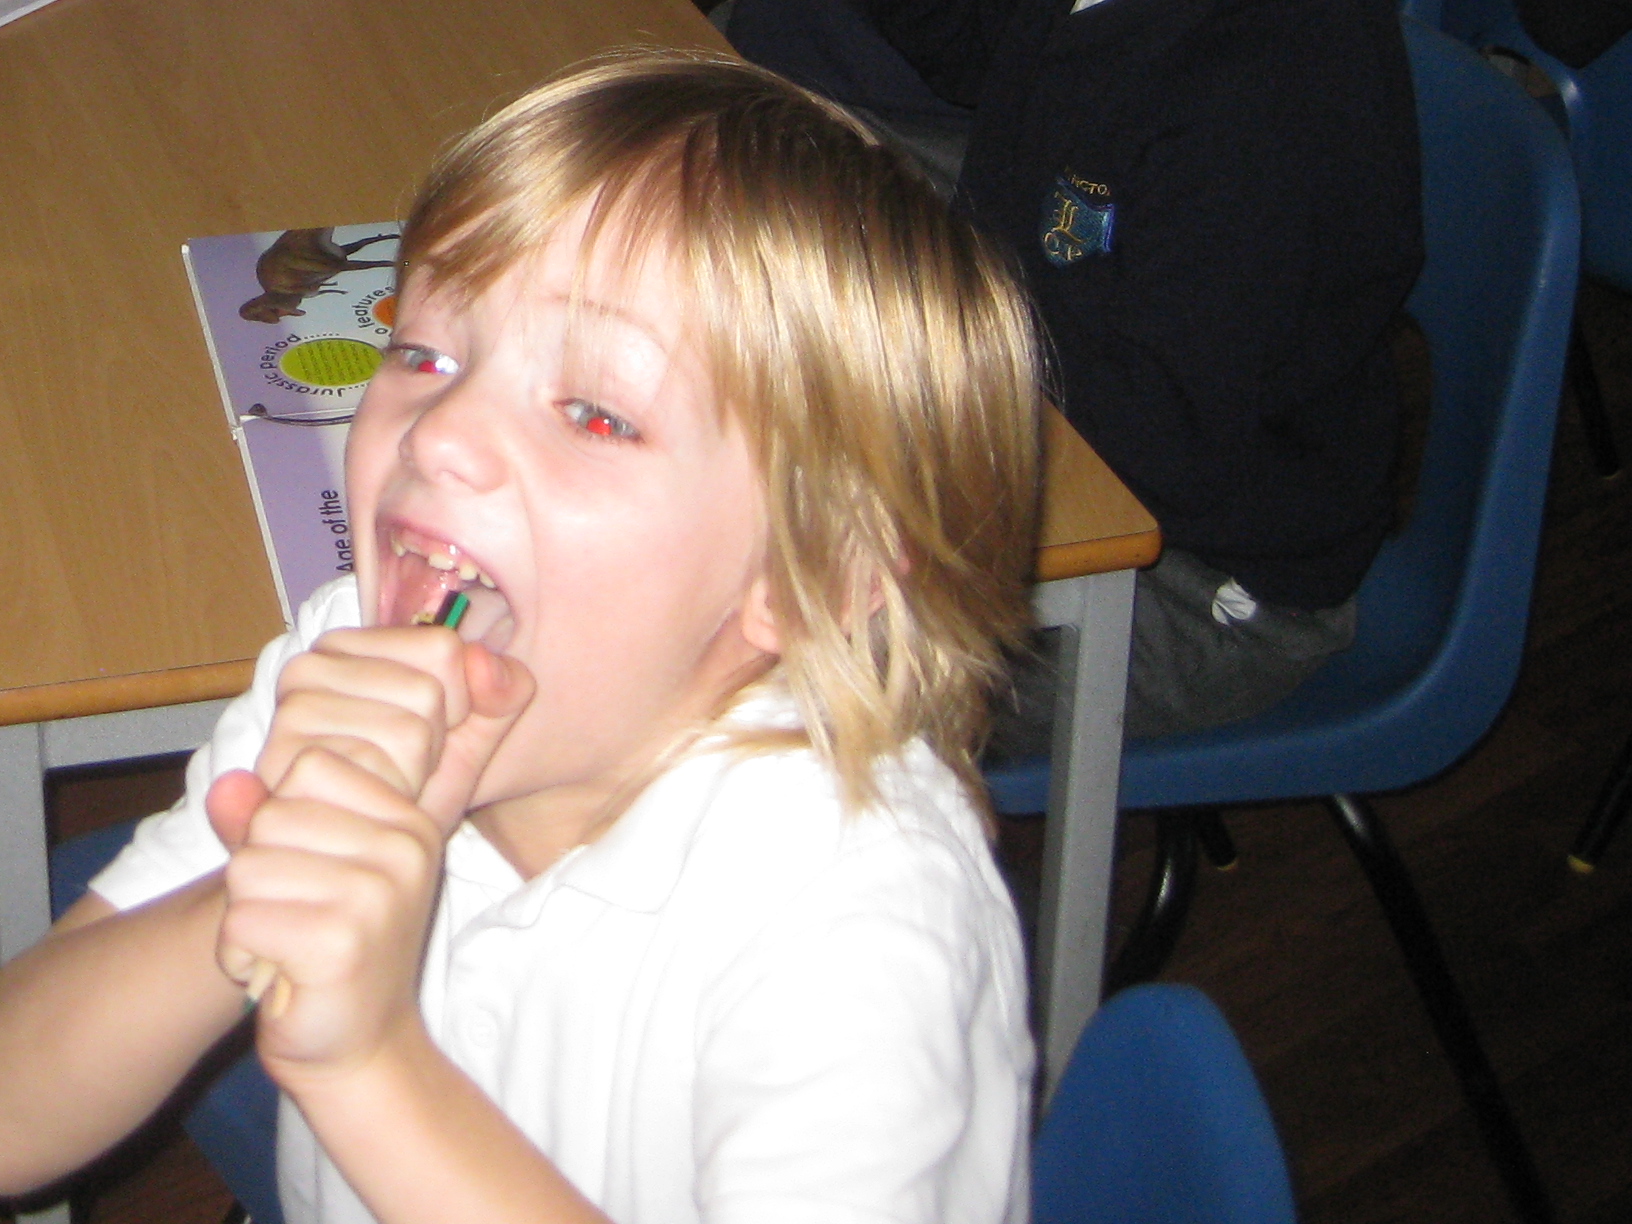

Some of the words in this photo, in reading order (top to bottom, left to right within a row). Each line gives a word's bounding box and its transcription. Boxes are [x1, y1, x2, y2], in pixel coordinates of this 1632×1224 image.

[318, 489, 344, 516] the
[321, 519, 348, 534] of
[334, 538, 355, 572] Age
